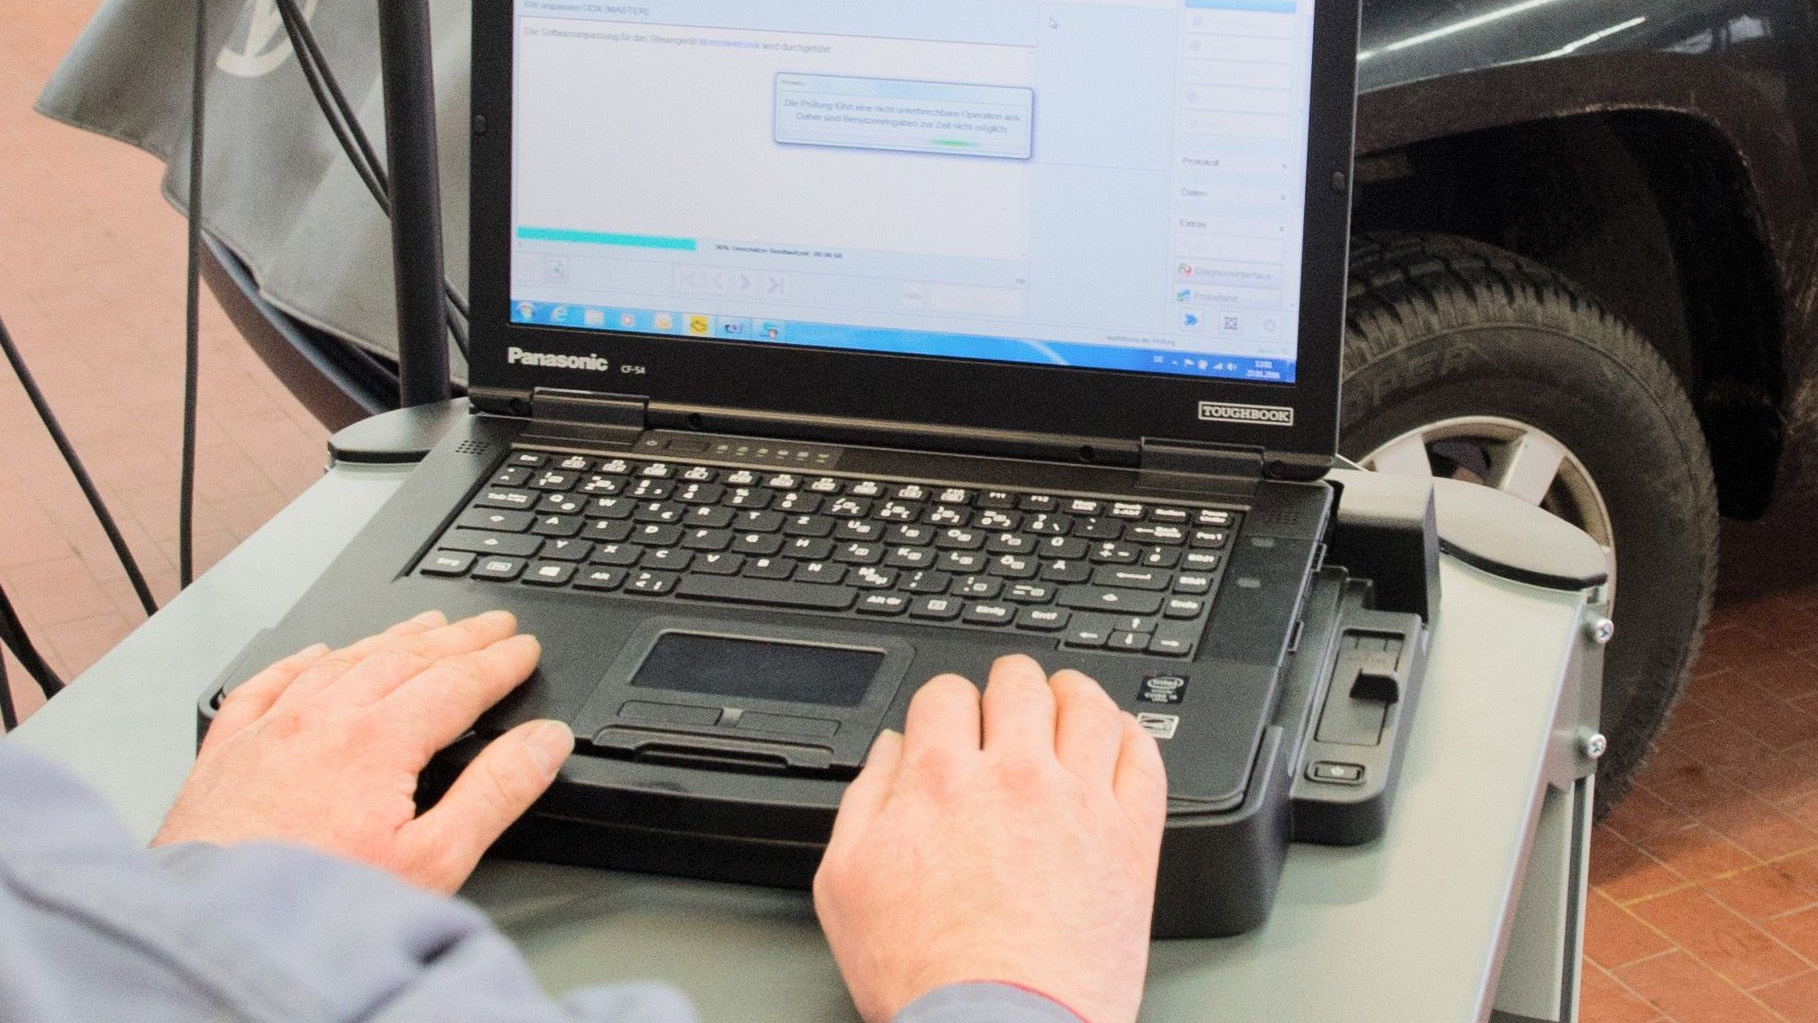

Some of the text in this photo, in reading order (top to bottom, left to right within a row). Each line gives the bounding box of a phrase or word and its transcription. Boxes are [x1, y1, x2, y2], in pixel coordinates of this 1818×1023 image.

[784, 99, 799, 108] Die
[800, 99, 834, 111] Prüfung
[508, 346, 608, 371] Panasonic
[620, 365, 646, 375] CF-54
[1203, 405, 1289, 422] TOUGHBOOK
